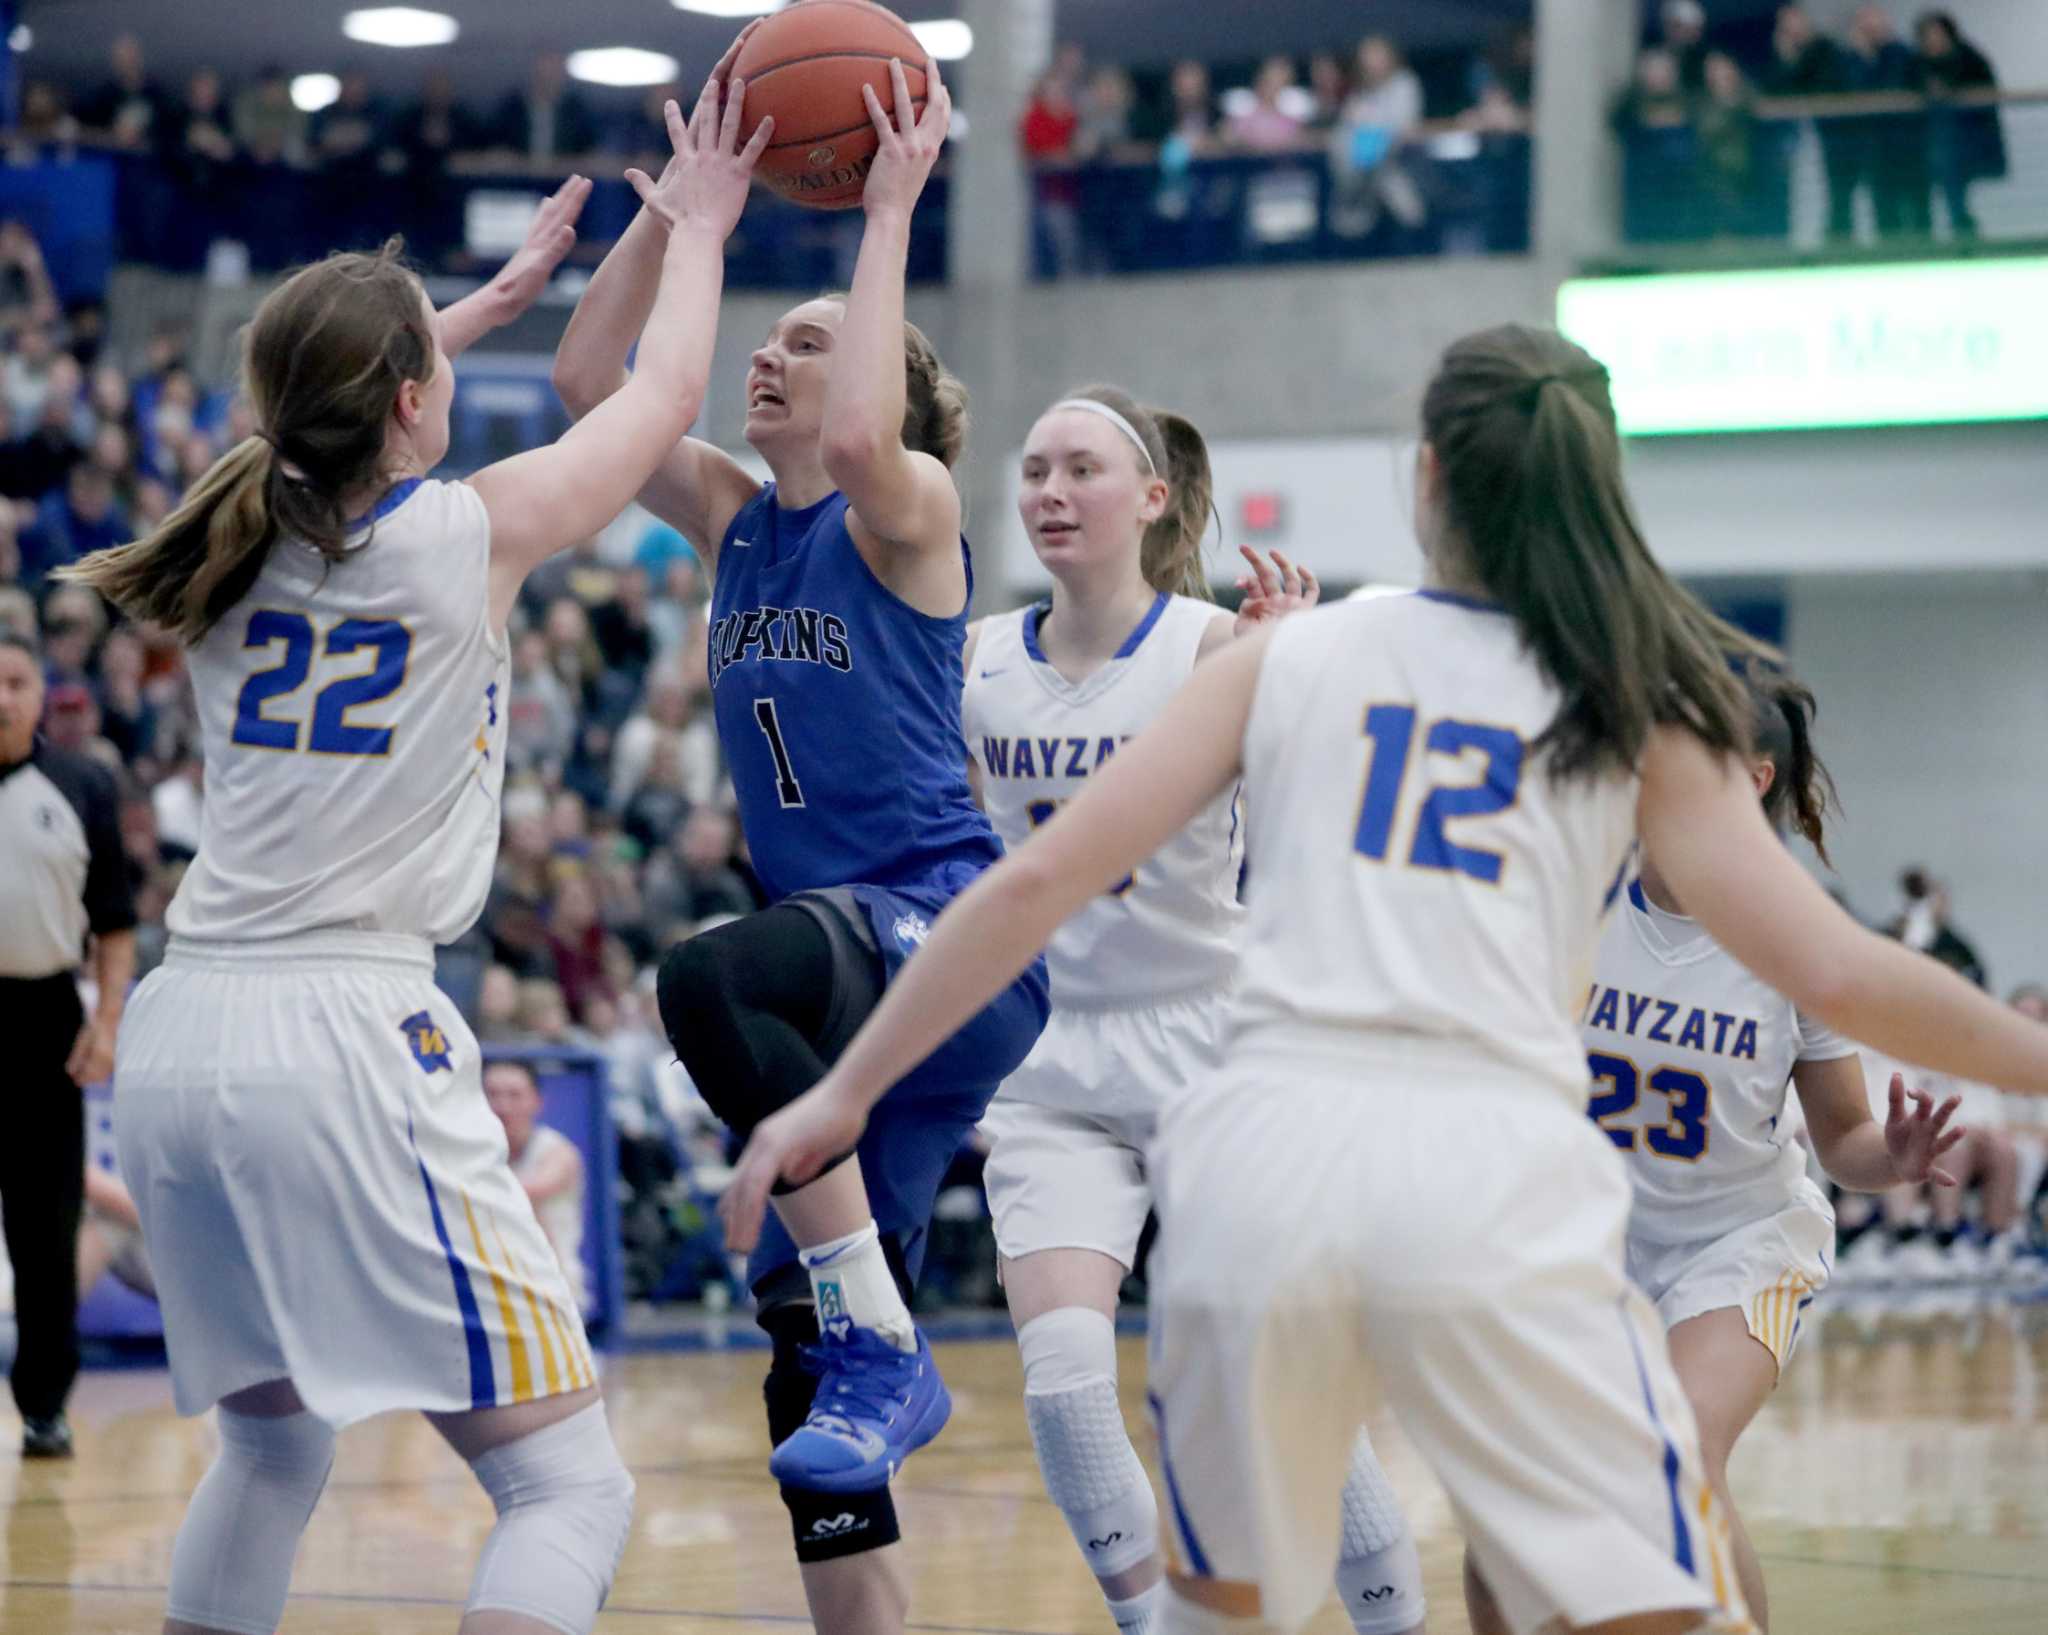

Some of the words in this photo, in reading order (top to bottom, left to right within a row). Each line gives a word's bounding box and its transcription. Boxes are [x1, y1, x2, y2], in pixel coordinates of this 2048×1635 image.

[229, 608, 416, 758] 22
[754, 697, 806, 809] 1
[982, 735, 1130, 779] WAYZA
[1352, 703, 1527, 888] 12
[1583, 983, 1758, 1061] AYZATA
[1585, 1048, 1713, 1164] 23
